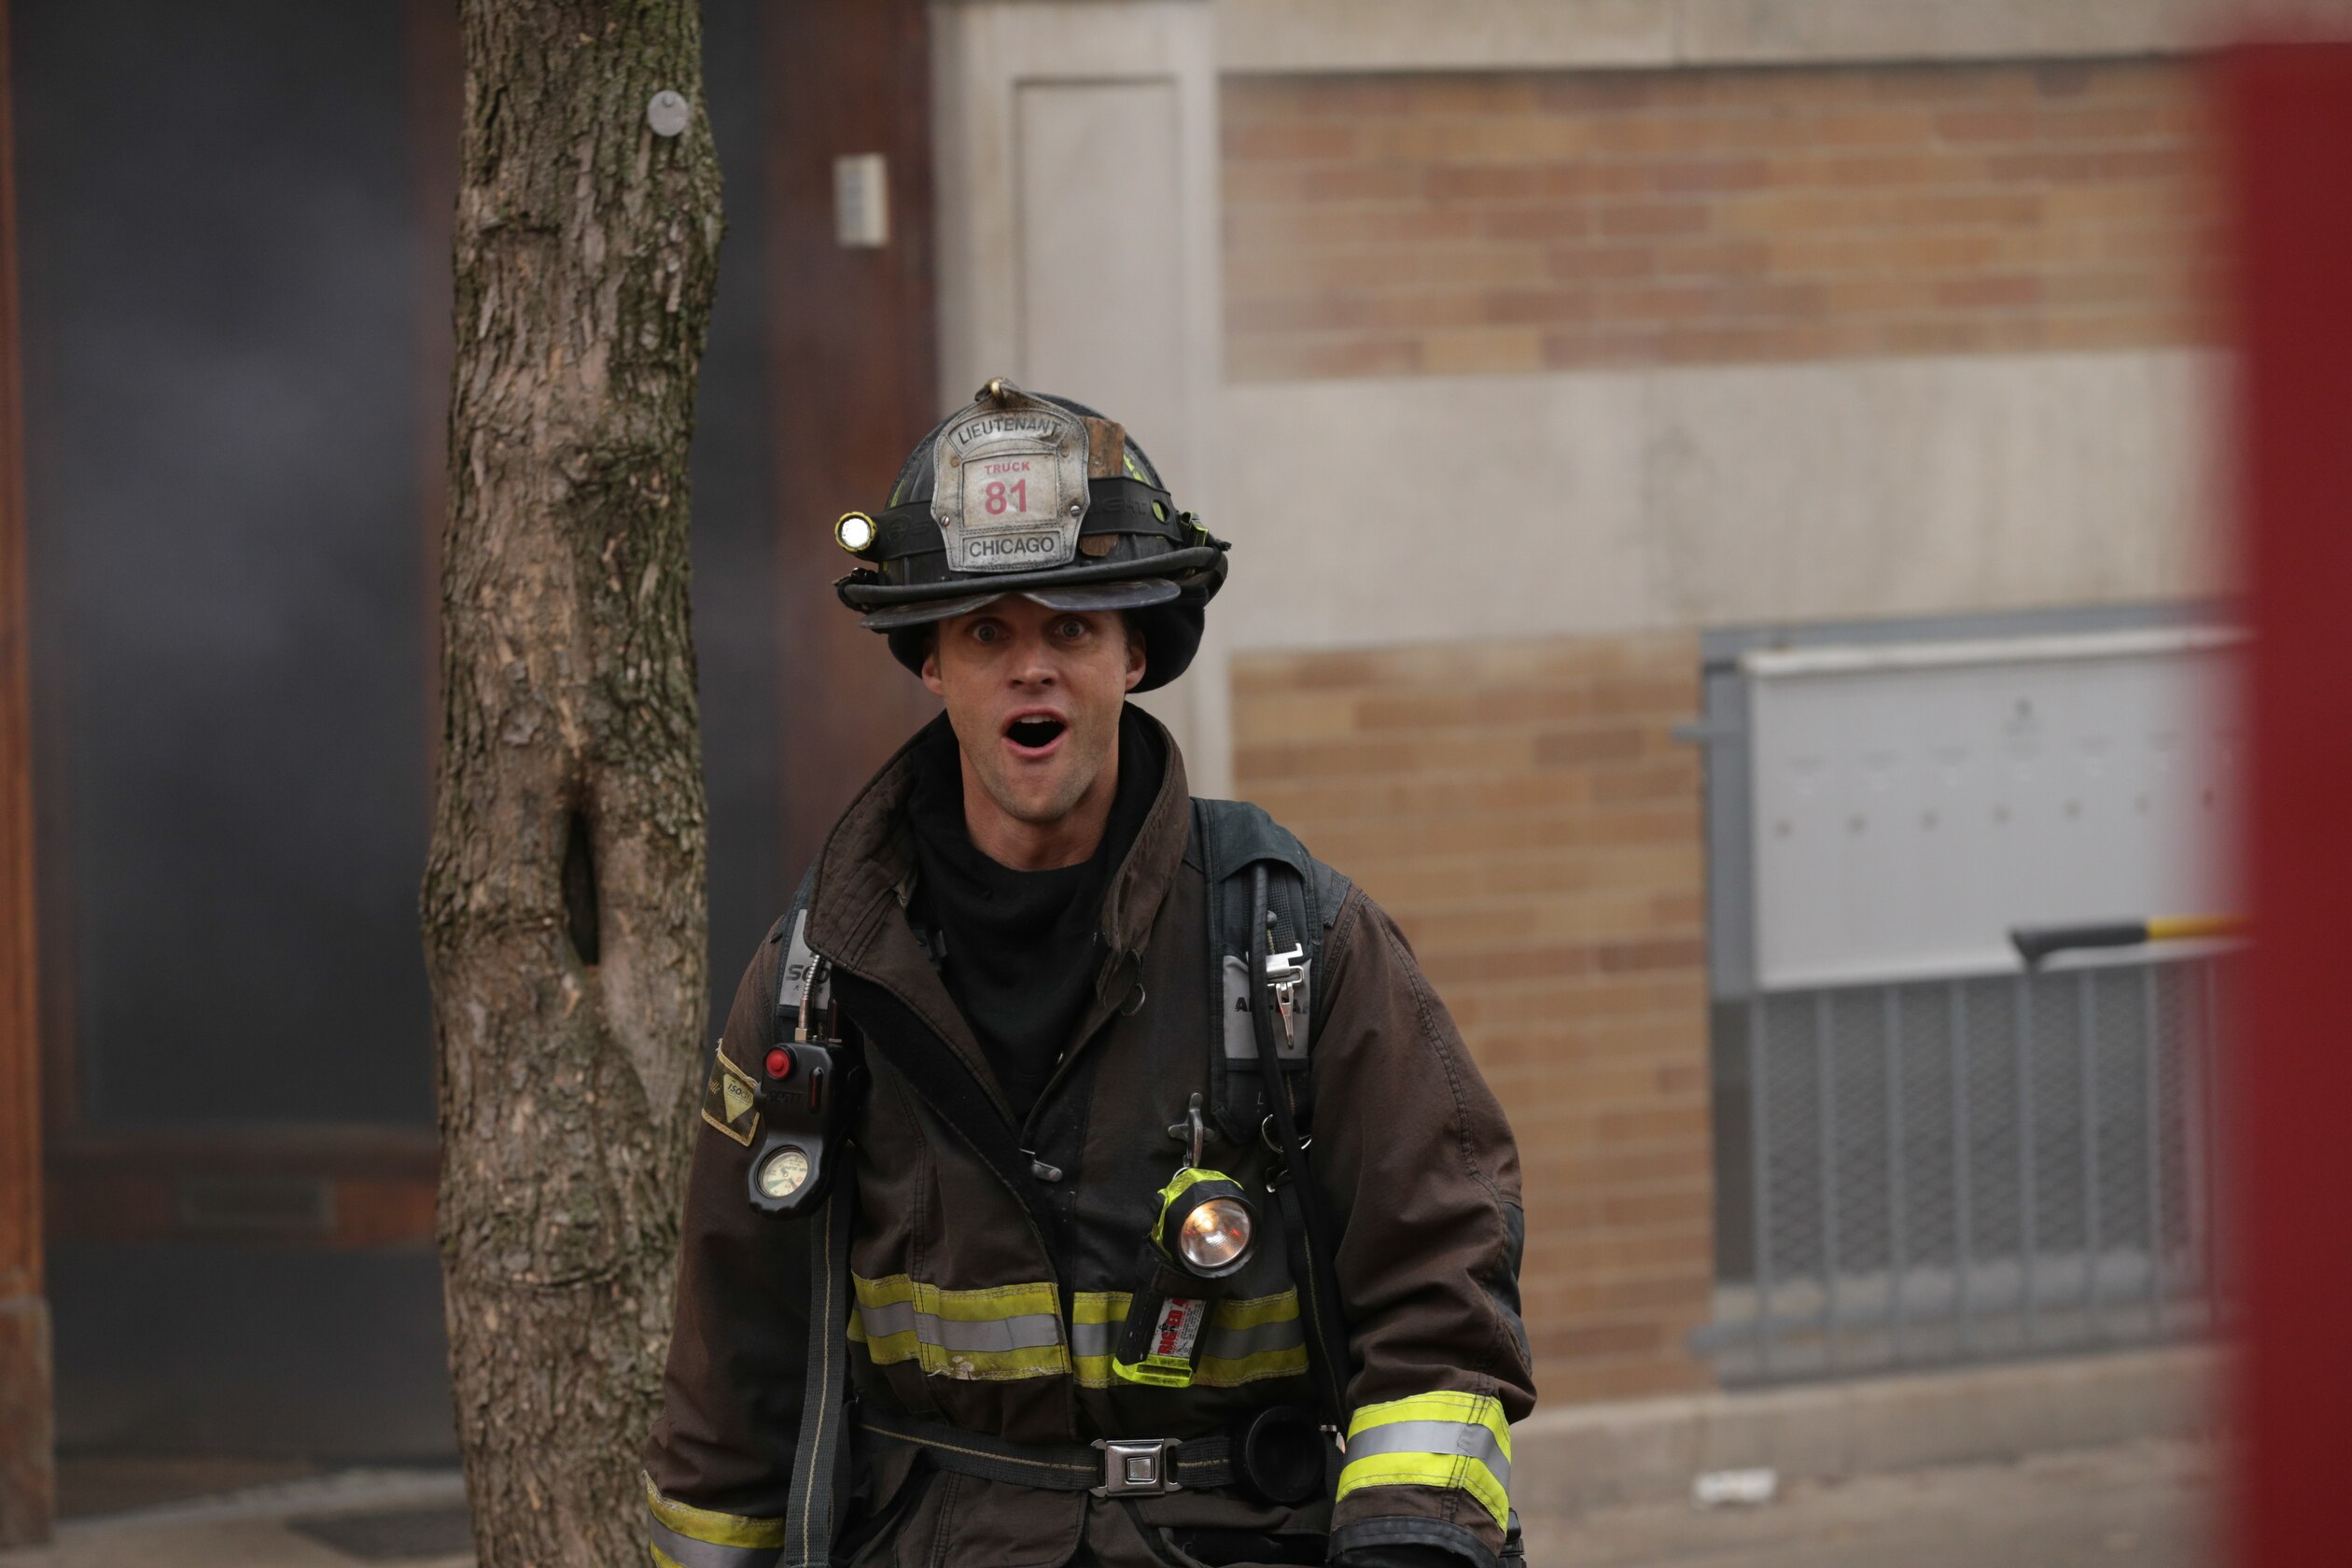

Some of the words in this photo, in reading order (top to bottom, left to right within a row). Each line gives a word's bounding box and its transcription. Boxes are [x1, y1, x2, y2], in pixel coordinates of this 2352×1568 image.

[958, 418, 1062, 445] LIEUTENANT
[985, 461, 1031, 475] TRUCK
[985, 479, 1028, 515] 81
[969, 537, 1055, 558] CHICAGO
